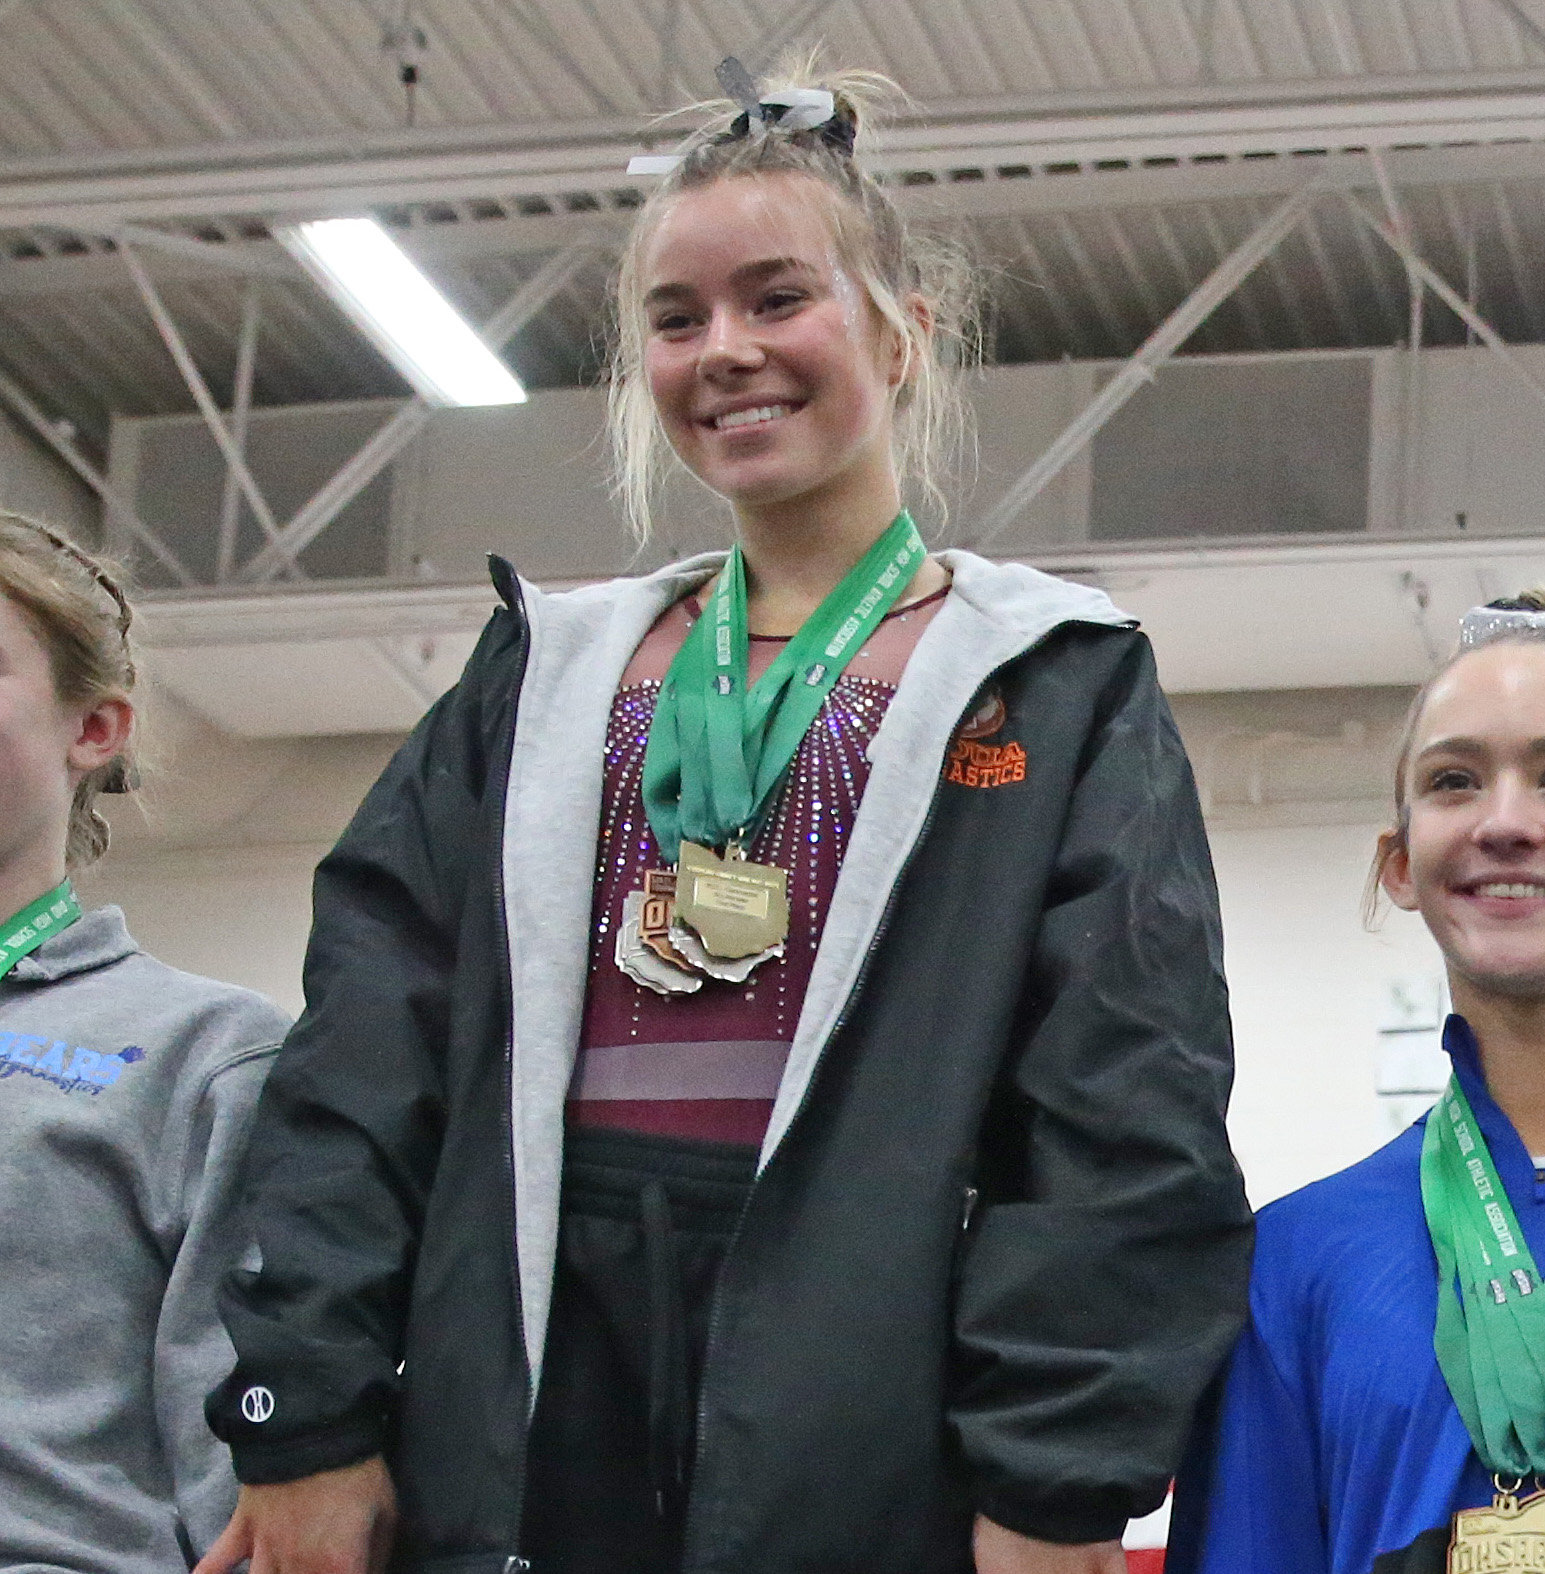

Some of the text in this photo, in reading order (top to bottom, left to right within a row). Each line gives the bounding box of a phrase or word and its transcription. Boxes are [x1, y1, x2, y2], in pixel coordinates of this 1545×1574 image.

[946, 760, 1026, 788] ASTICS
[1466, 1158, 1493, 1200] ATHLETIC
[1484, 1201, 1518, 1257] ASSOCIATION
